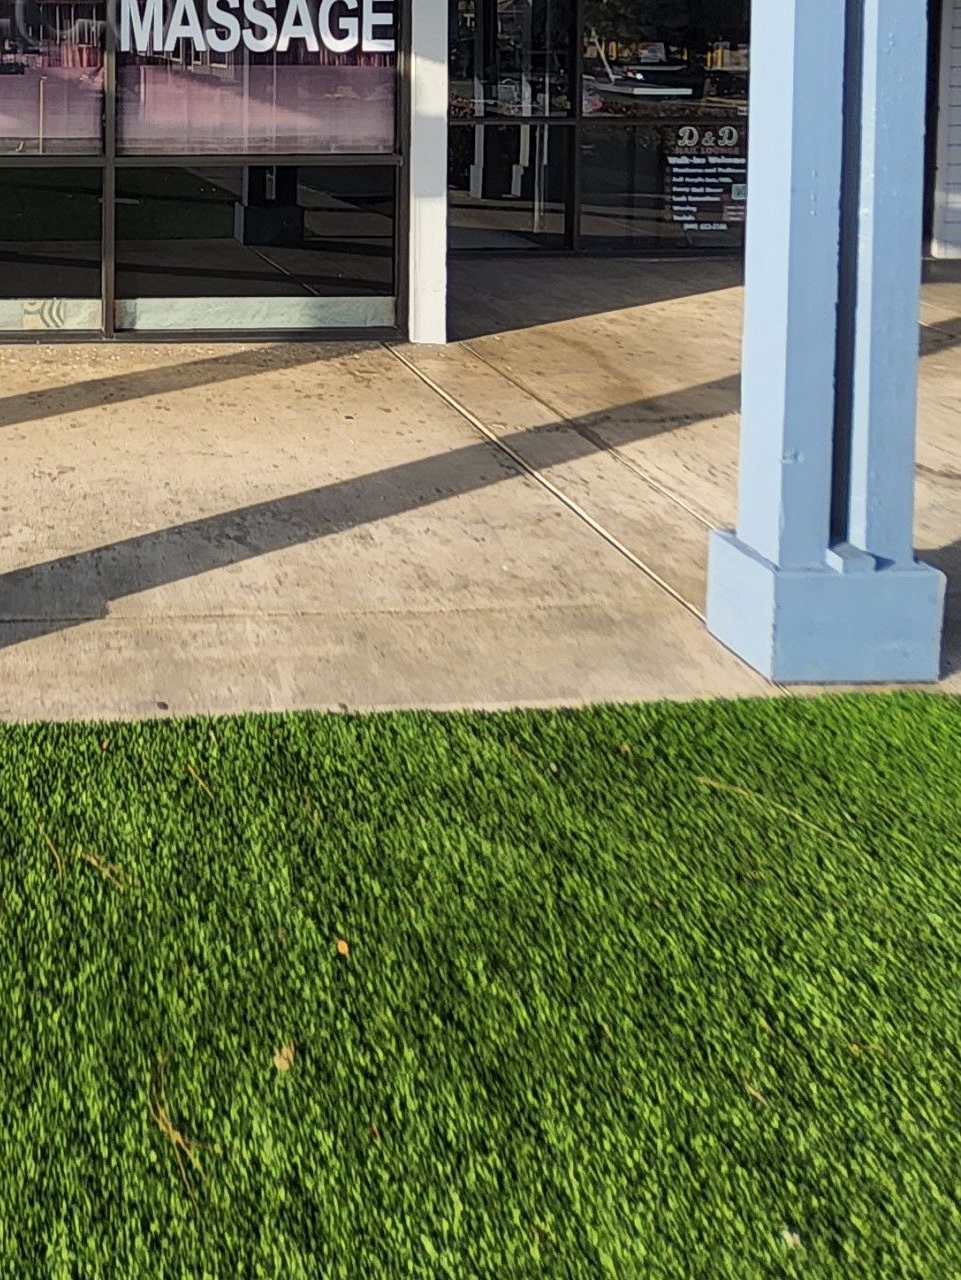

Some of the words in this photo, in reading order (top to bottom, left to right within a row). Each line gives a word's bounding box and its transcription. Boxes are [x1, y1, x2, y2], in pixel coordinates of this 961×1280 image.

[678, 125, 699, 147] D
[700, 131, 716, 146] &
[717, 125, 738, 147] D
